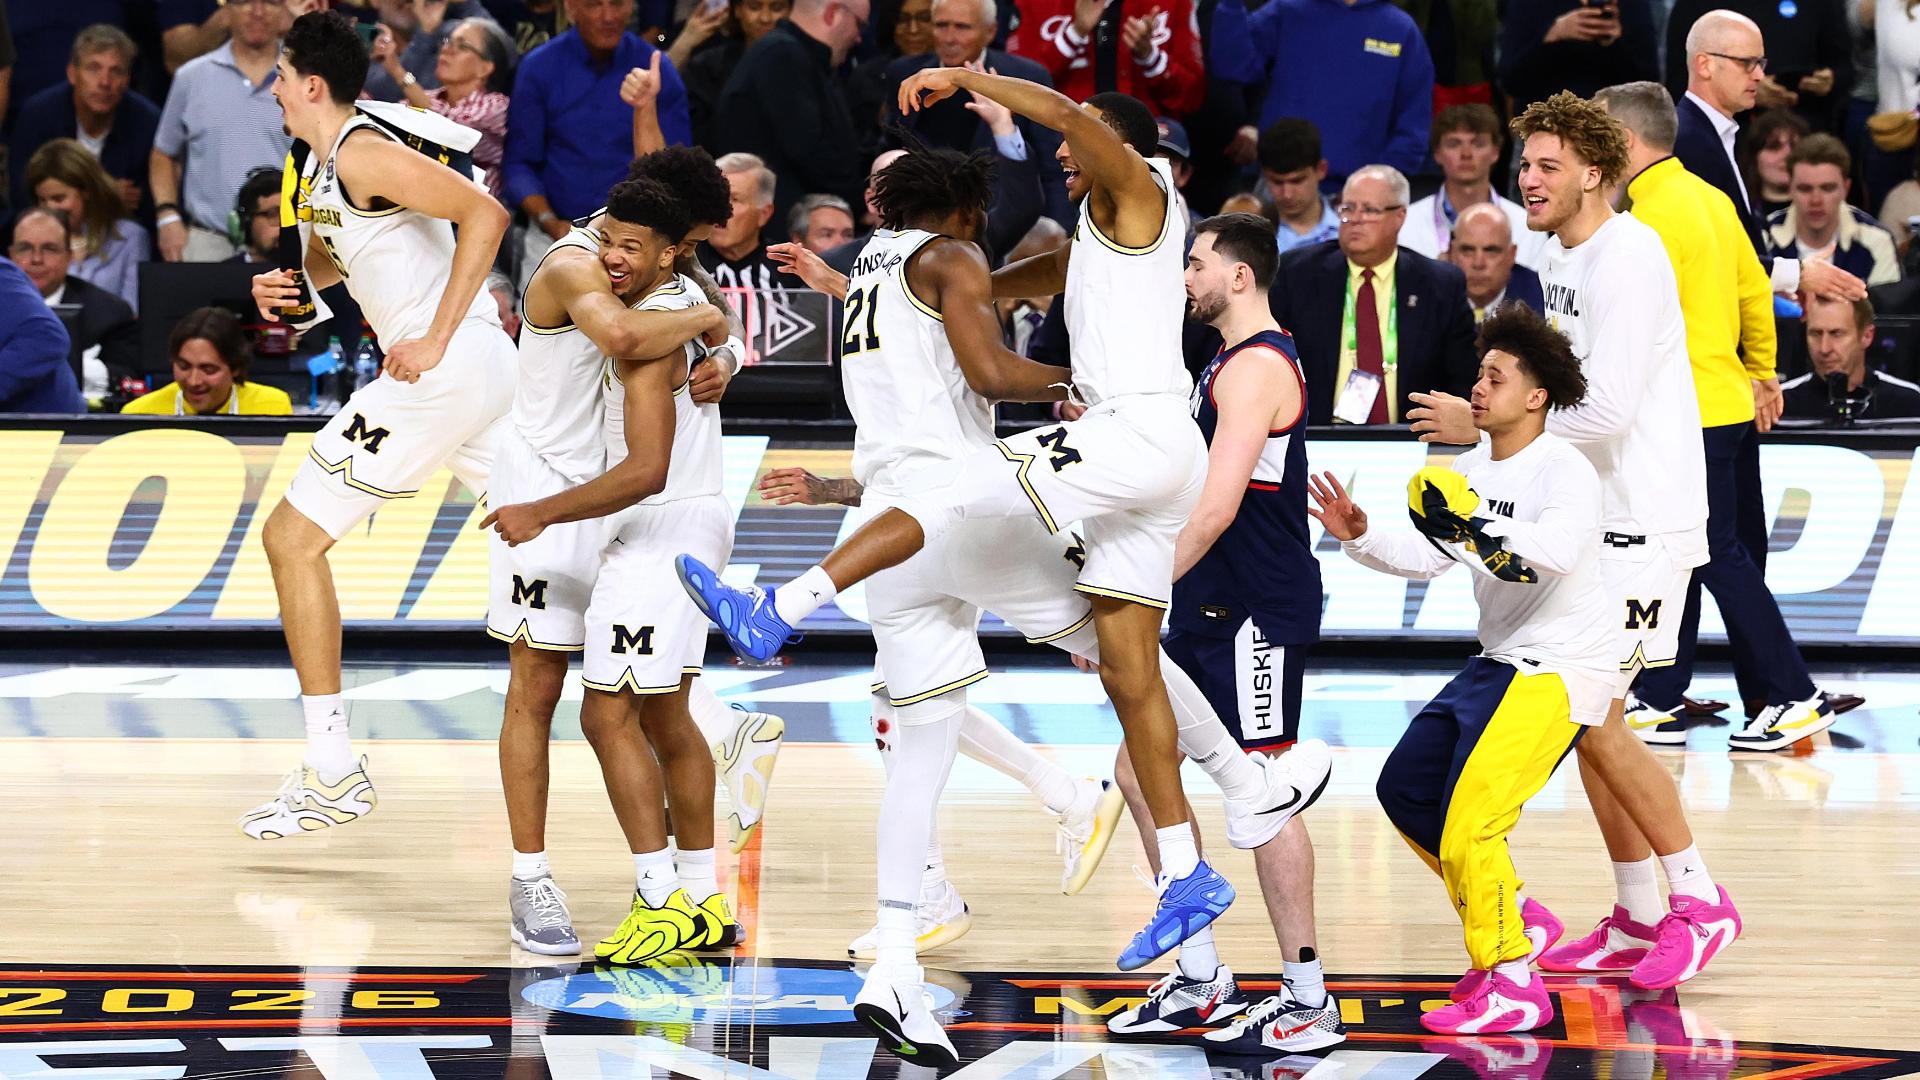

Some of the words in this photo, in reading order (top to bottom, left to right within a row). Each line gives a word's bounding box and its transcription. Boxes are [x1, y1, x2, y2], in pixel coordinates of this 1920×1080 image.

[841, 283, 881, 356] 21
[341, 411, 391, 455] M
[1035, 425, 1084, 474] M
[511, 573, 549, 611] M
[1624, 598, 1663, 631] M
[611, 623, 656, 656] M
[0, 987, 441, 1016] 2026
